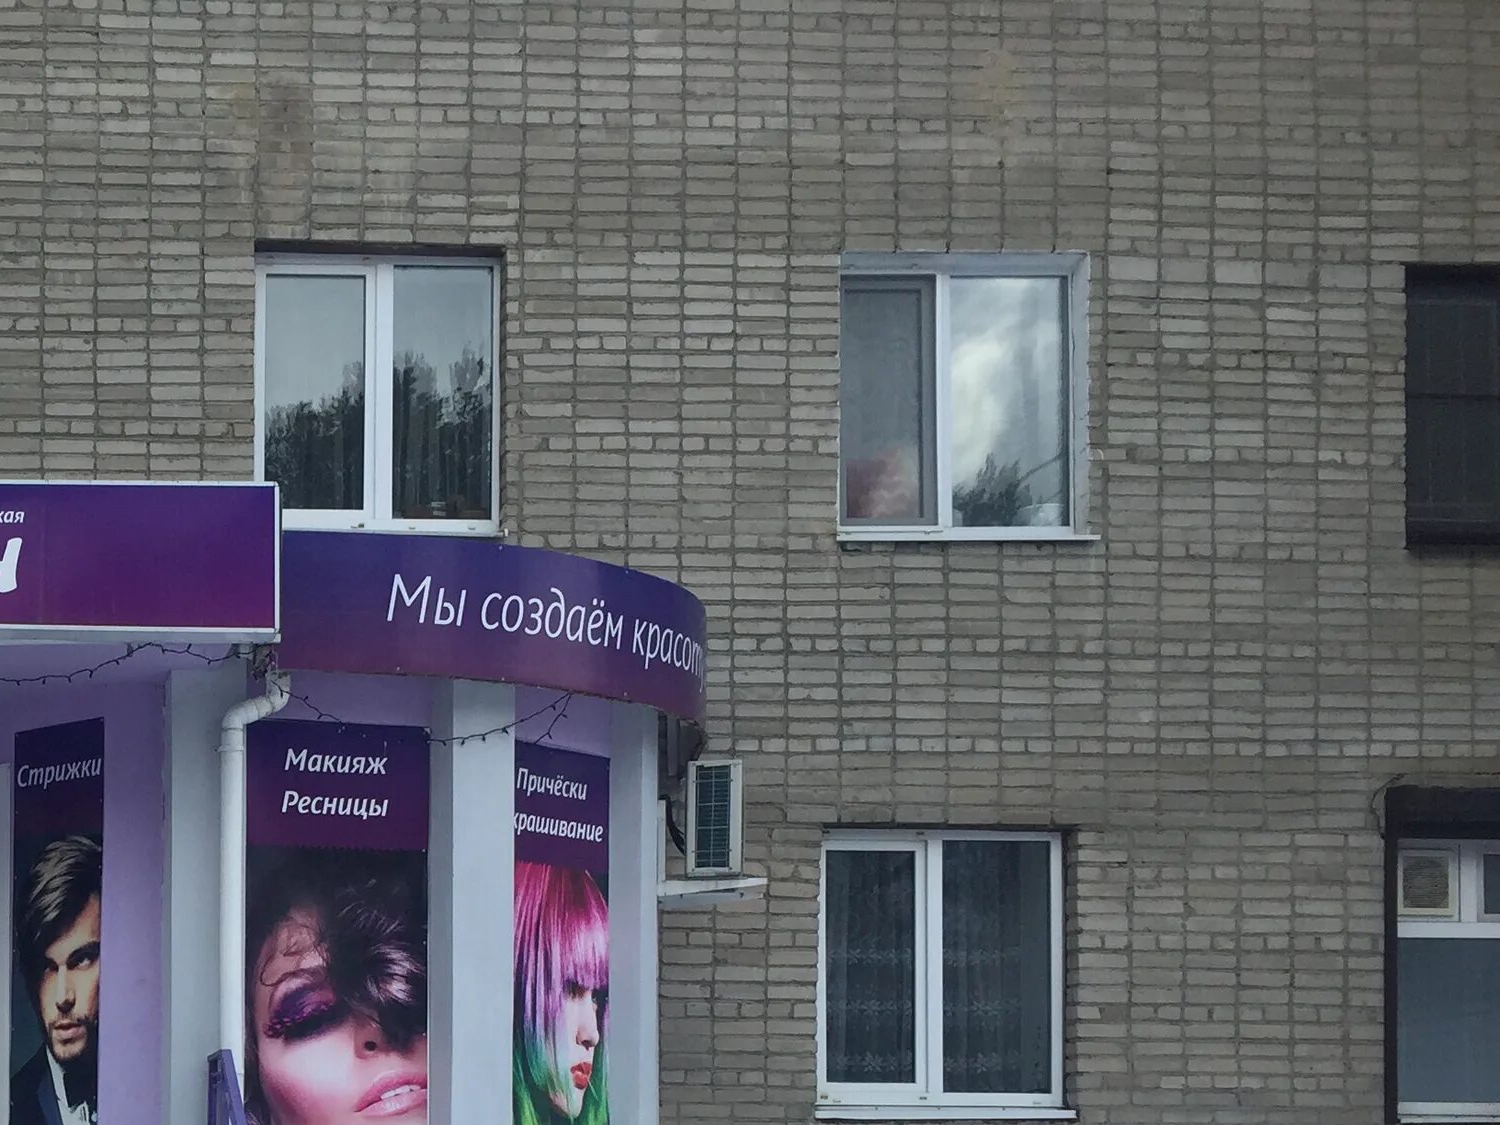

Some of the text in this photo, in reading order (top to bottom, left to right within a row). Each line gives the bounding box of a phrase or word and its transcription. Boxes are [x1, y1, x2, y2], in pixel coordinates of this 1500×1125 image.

[386, 573, 467, 627] Мы
[480, 586, 624, 651] создаём
[16, 758, 102, 790] Стрижки
[283, 748, 388, 777] Макияж
[516, 767, 588, 801] Причёски
[280, 789, 389, 820] Ресницы
